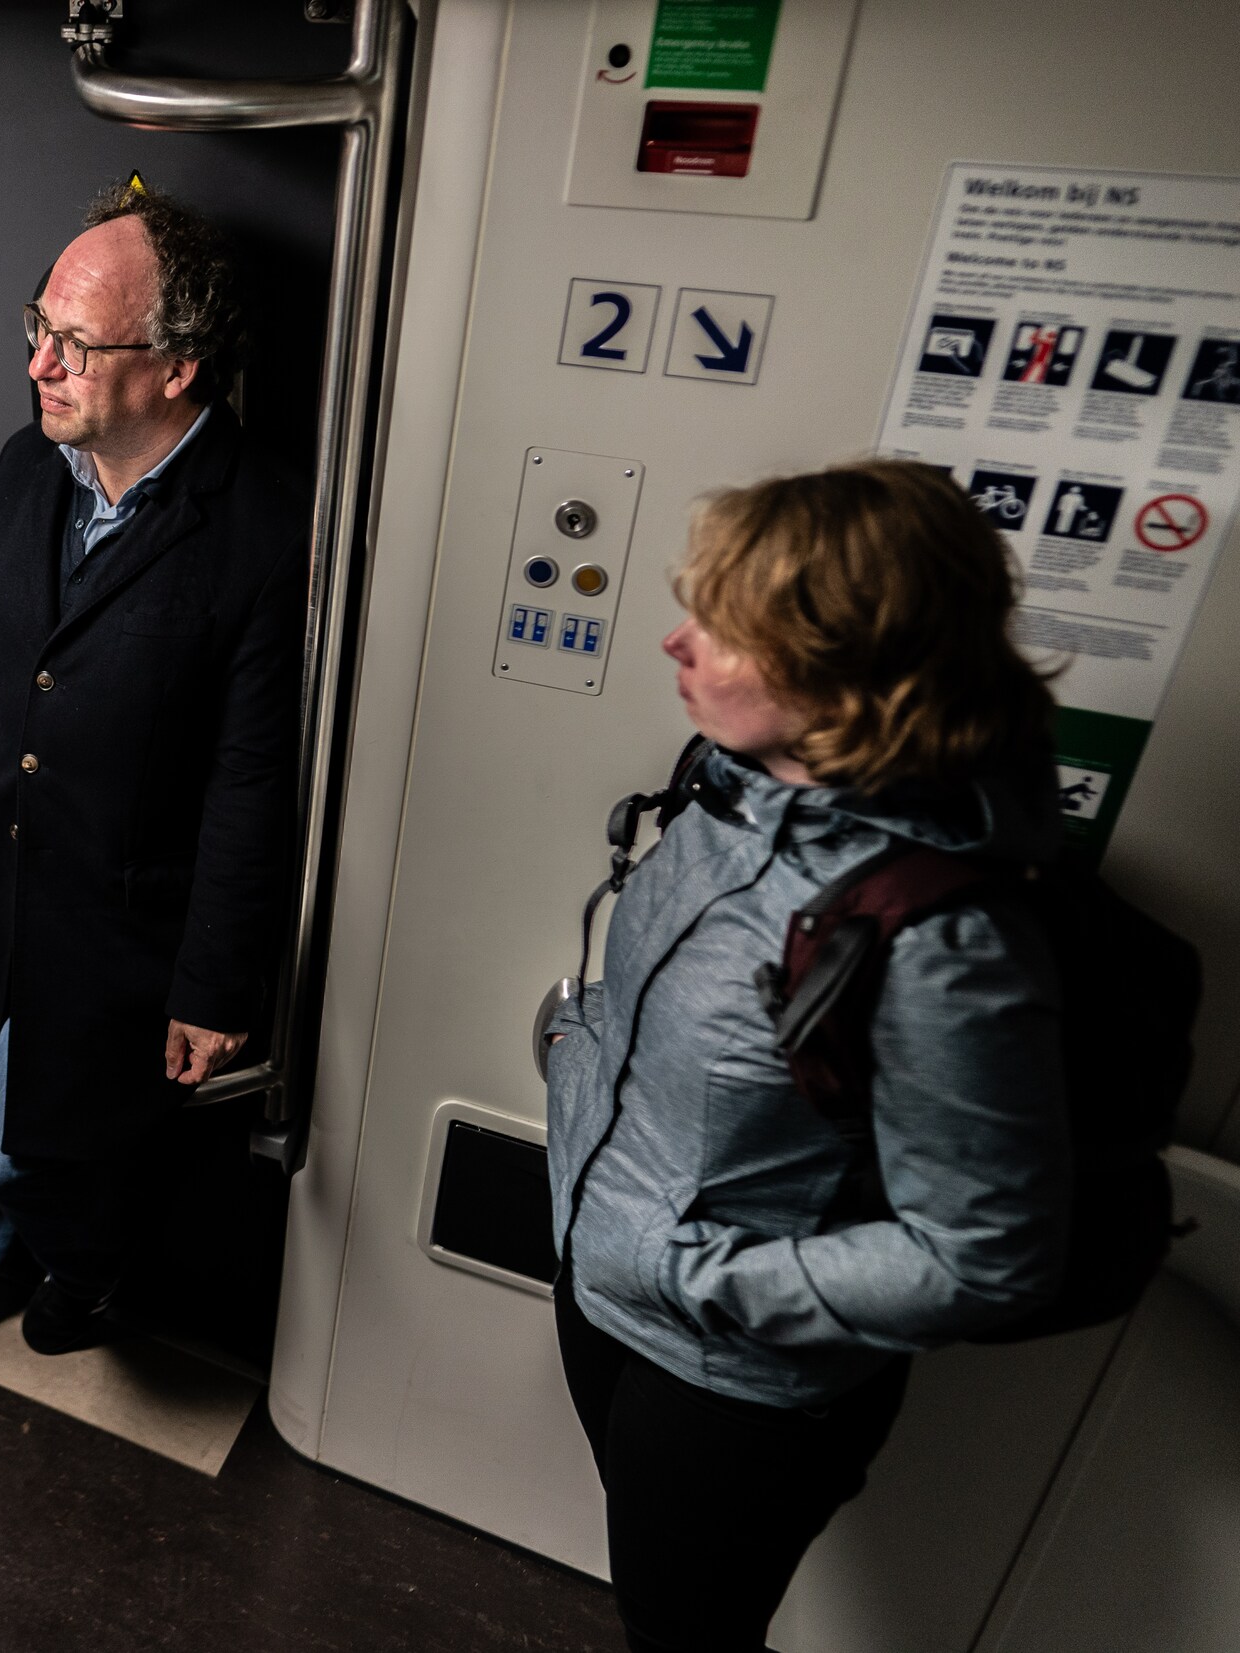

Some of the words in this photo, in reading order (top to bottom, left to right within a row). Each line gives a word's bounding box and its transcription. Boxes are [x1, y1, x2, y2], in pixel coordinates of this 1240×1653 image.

[964, 178, 1060, 199] Welkom
[1065, 183, 1100, 207] bij
[1105, 187, 1141, 206] NS
[580, 291, 632, 361] 2
